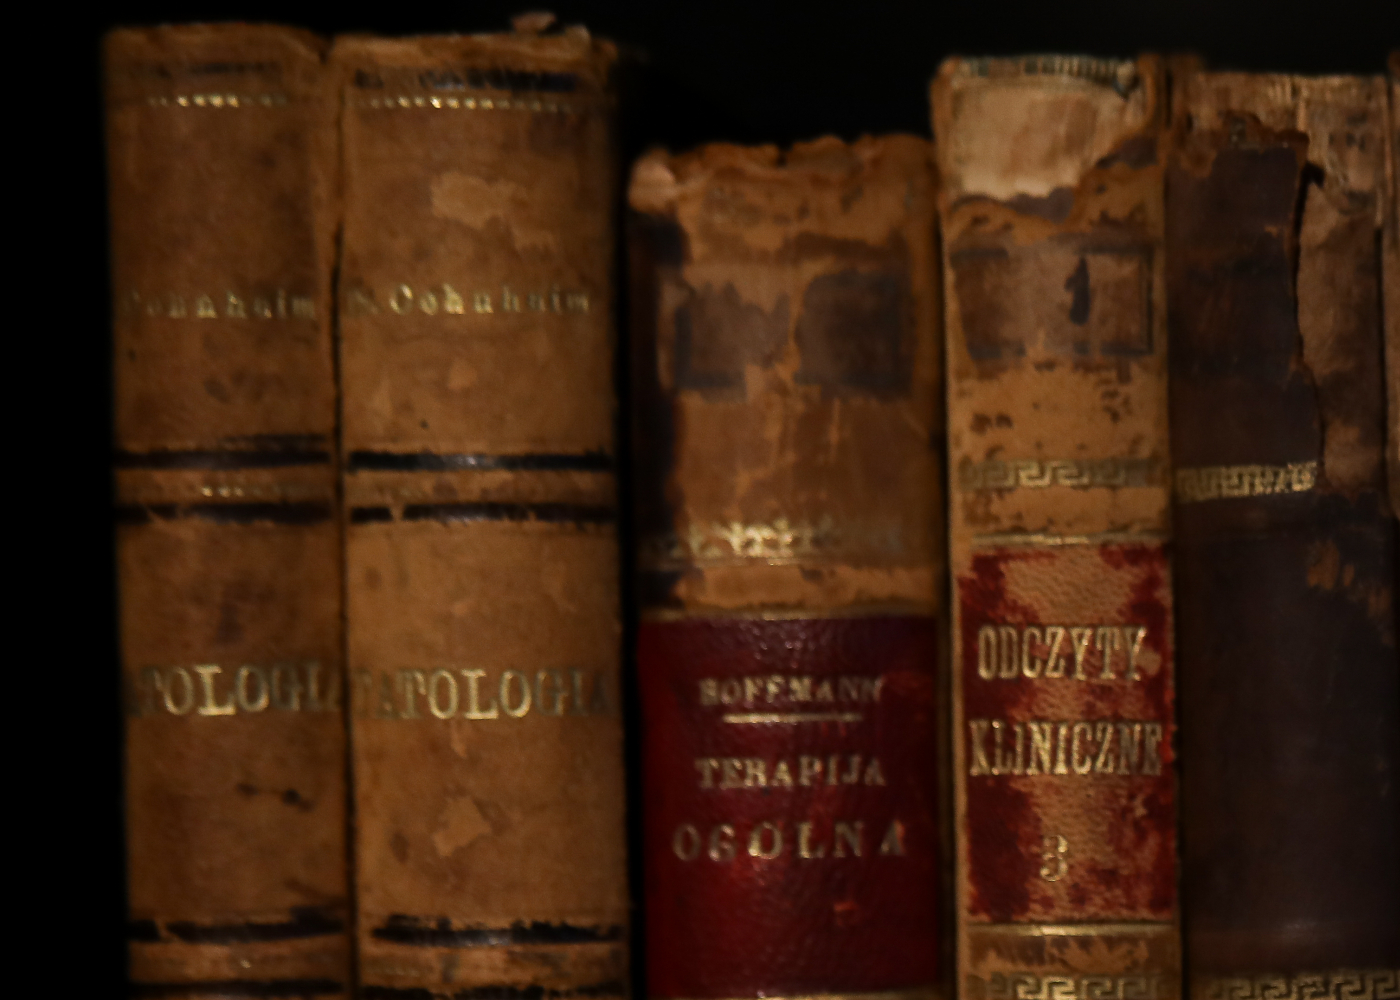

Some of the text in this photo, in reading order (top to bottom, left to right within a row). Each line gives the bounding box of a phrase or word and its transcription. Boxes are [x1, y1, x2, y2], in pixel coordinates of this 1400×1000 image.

[977, 625, 1148, 681] ODCZYTY
[694, 756, 886, 789] TERAPIJA
[969, 718, 1163, 777] KLINICZNE
[1041, 834, 1069, 882] 3
